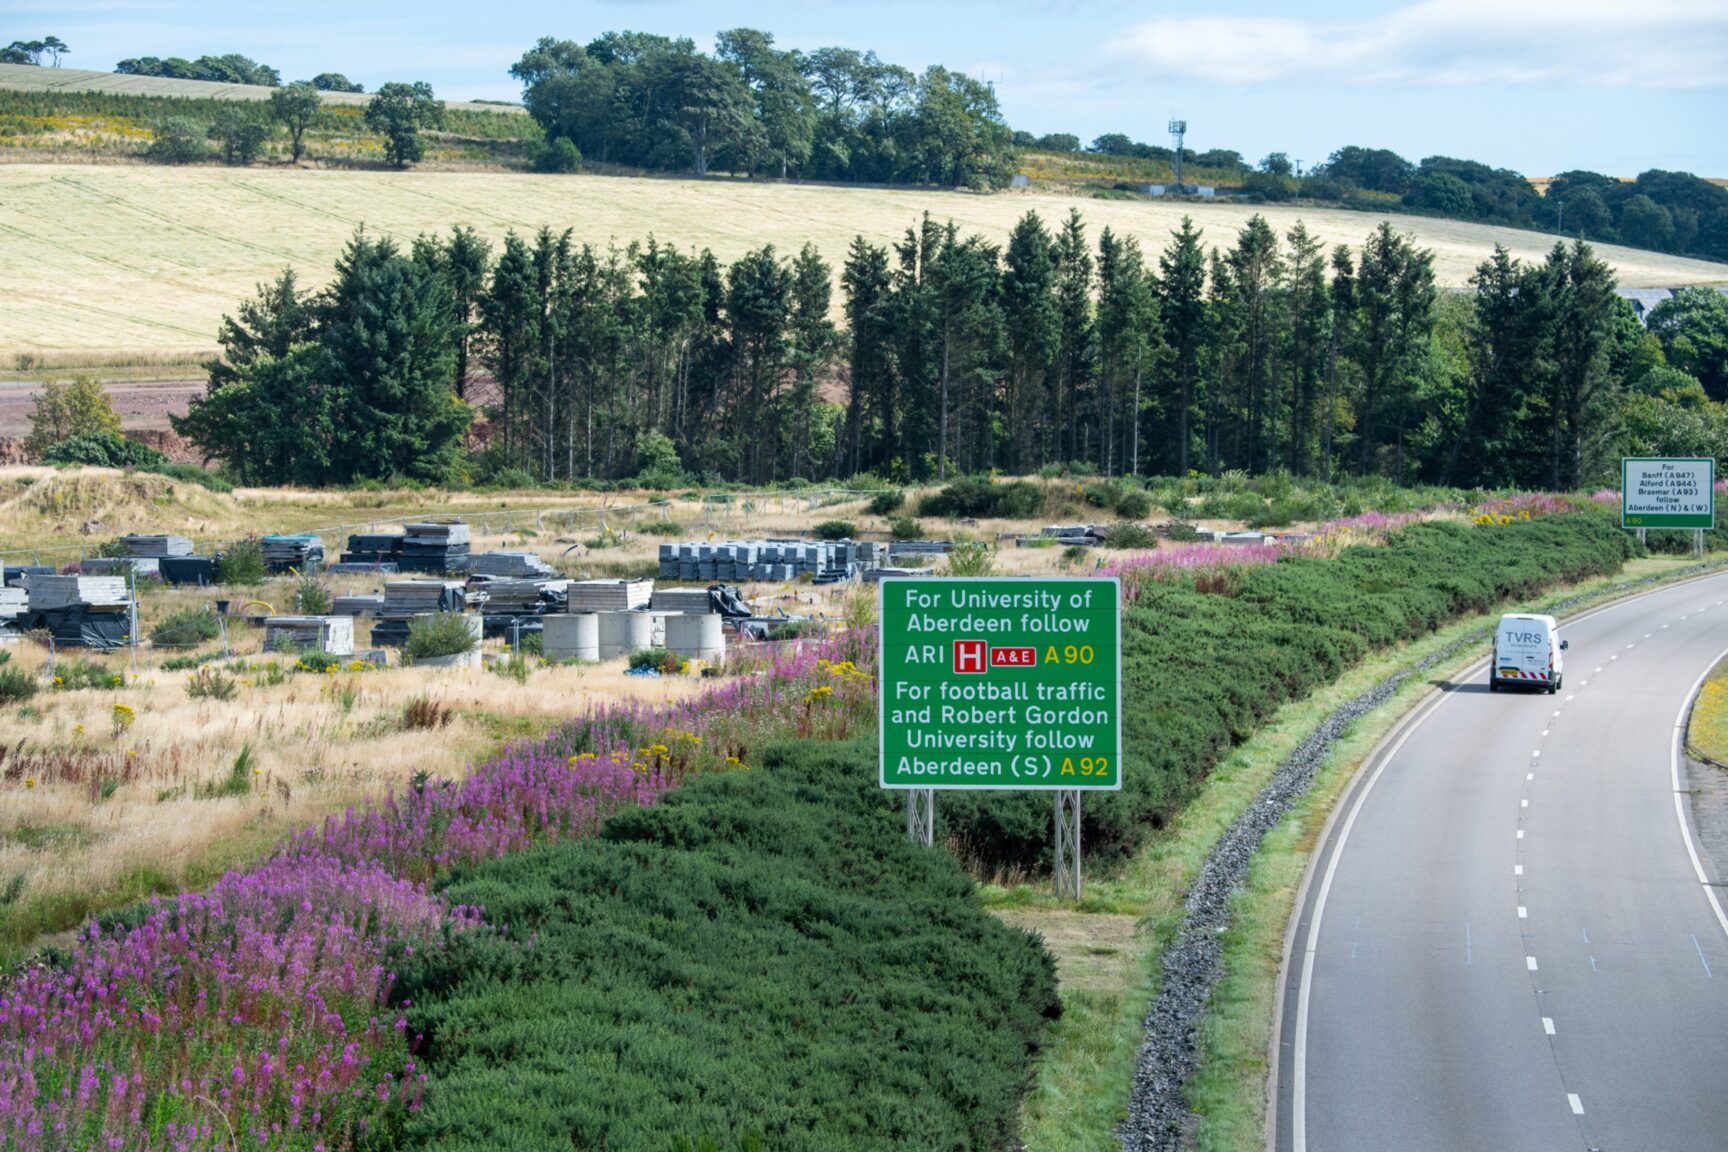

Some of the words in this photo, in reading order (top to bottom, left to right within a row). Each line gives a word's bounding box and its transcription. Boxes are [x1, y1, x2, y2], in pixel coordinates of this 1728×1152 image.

[906, 590, 941, 608] For
[951, 590, 1061, 611] University
[1069, 590, 1093, 608] of
[907, 614, 1012, 632] Aberdeen
[1021, 614, 1090, 632] follow
[1506, 632, 1541, 643] TVRS
[905, 646, 944, 663] ARI
[896, 682, 931, 700] For
[940, 682, 1028, 700] football
[1037, 682, 1106, 700] traffic
[892, 706, 931, 724] and
[942, 706, 1016, 724] Robert
[1026, 706, 1108, 724] Gordon
[907, 730, 1017, 752] University
[1026, 730, 1095, 748] follow
[897, 756, 1001, 775] Aberdeen
[1011, 755, 1051, 778] (S)
